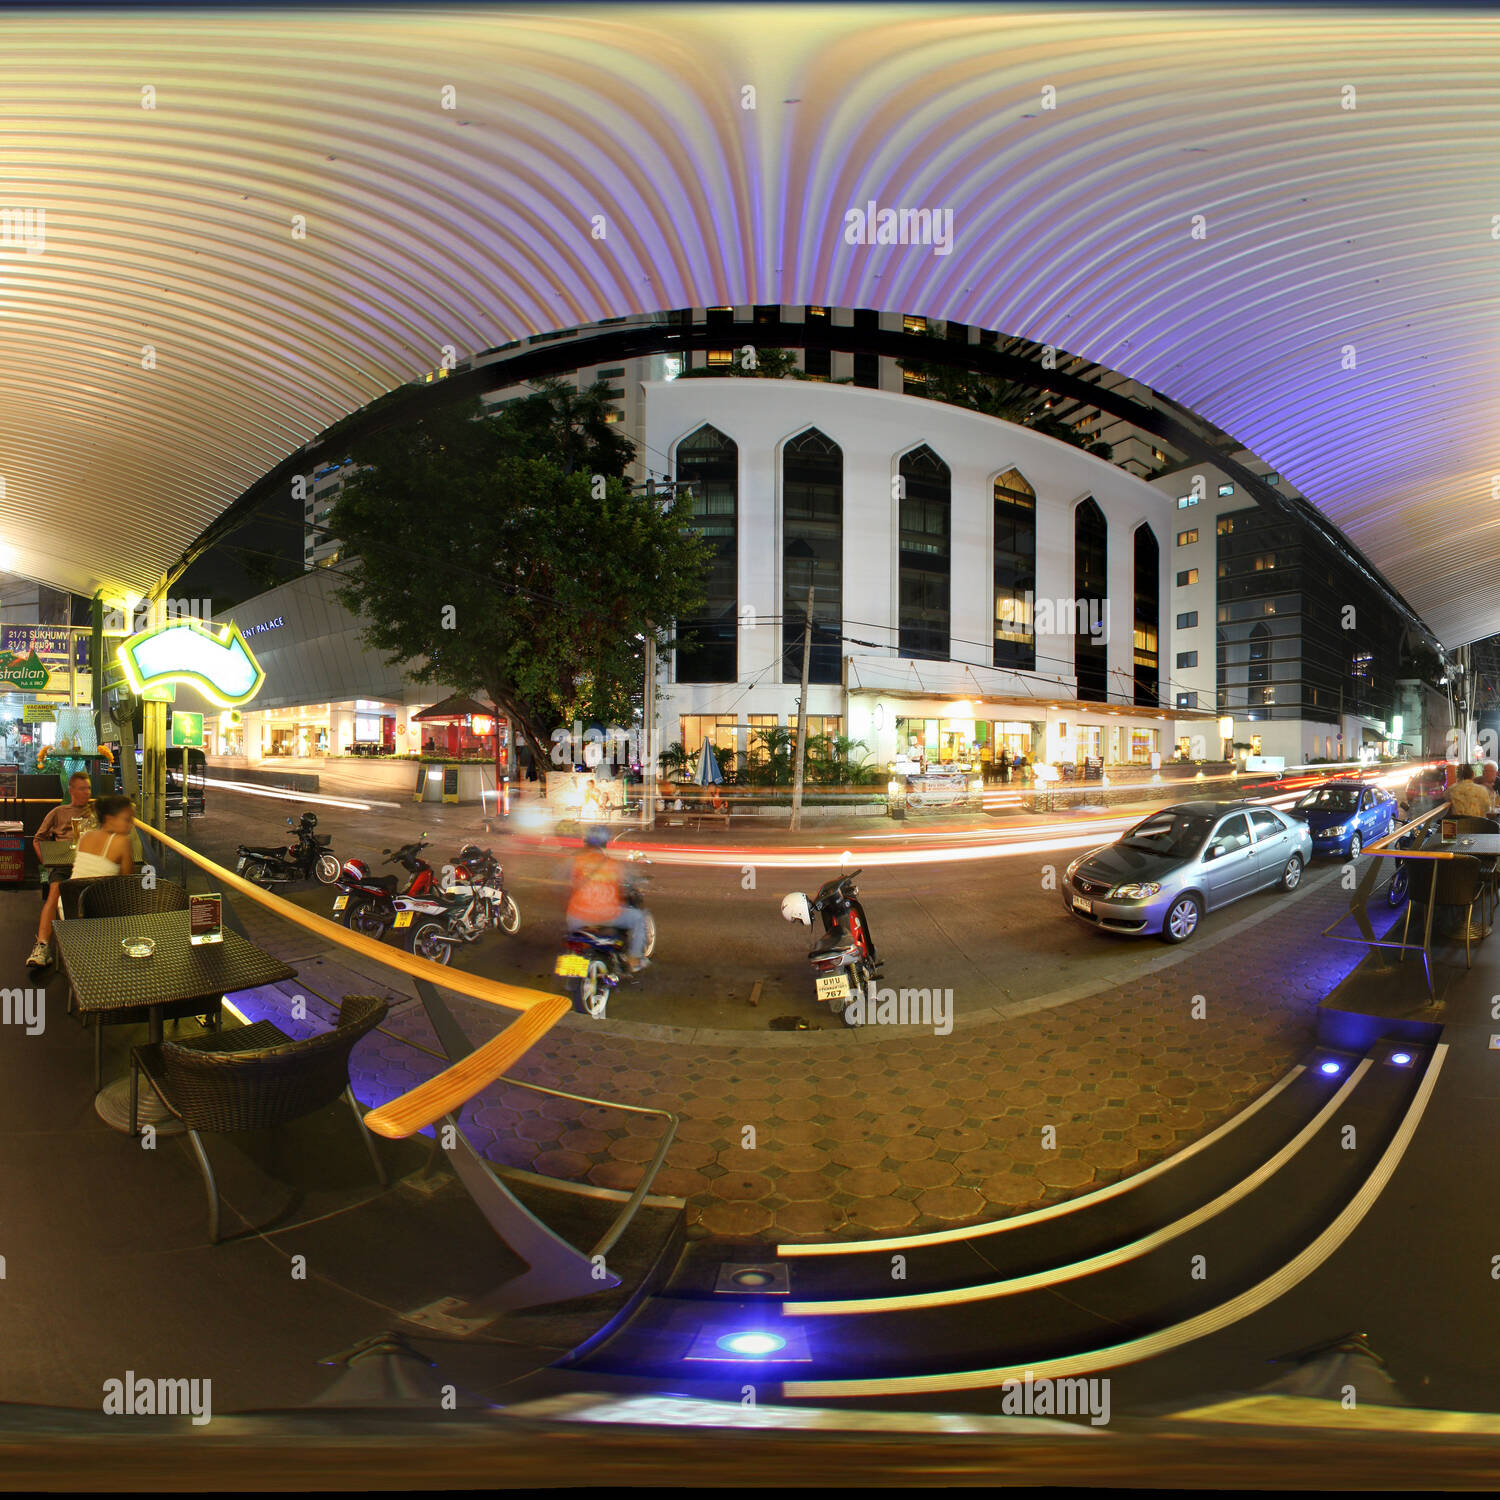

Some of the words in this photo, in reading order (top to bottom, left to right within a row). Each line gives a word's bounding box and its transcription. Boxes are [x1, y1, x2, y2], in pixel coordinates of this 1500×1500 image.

[241, 627, 256, 639] ENT
[256, 617, 284, 633] PALACE
[8, 631, 27, 639] 21/3
[29, 630, 69, 641] SUKHUMV
[8, 641, 27, 649] 21/3
[826, 990, 842, 998] 767
